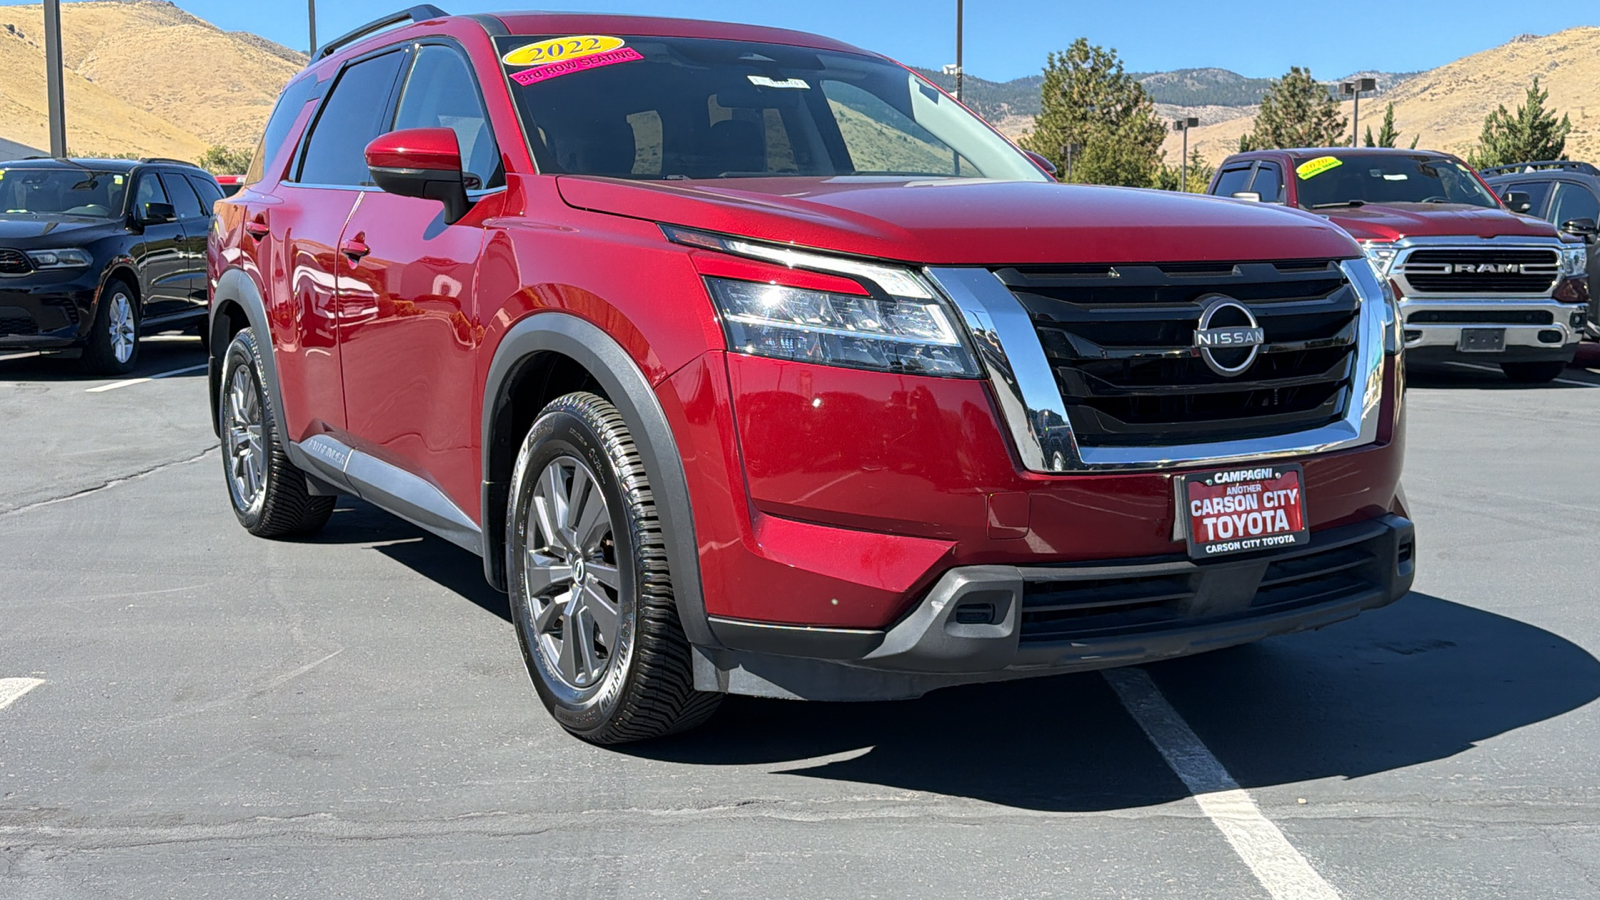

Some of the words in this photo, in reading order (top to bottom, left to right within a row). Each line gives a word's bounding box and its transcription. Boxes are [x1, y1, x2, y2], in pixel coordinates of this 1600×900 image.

[527, 38, 602, 62] 2022
[518, 68, 543, 83] 3rd
[546, 61, 577, 75] ROW
[580, 49, 636, 67] SEATING
[1454, 263, 1518, 273] RAM
[1197, 331, 1264, 345] NISSAN
[1214, 467, 1273, 484] CAMPAGNI
[1226, 483, 1262, 495] ANOTHER
[1190, 493, 1258, 517] CARSON
[1263, 488, 1298, 508] CITY
[1202, 508, 1290, 541] TOYOTA
[1205, 541, 1241, 554] CARSON
[1242, 538, 1261, 549] CITY
[1262, 534, 1295, 546] TOYOTA
[600, 640, 628, 710] MICHELIN
